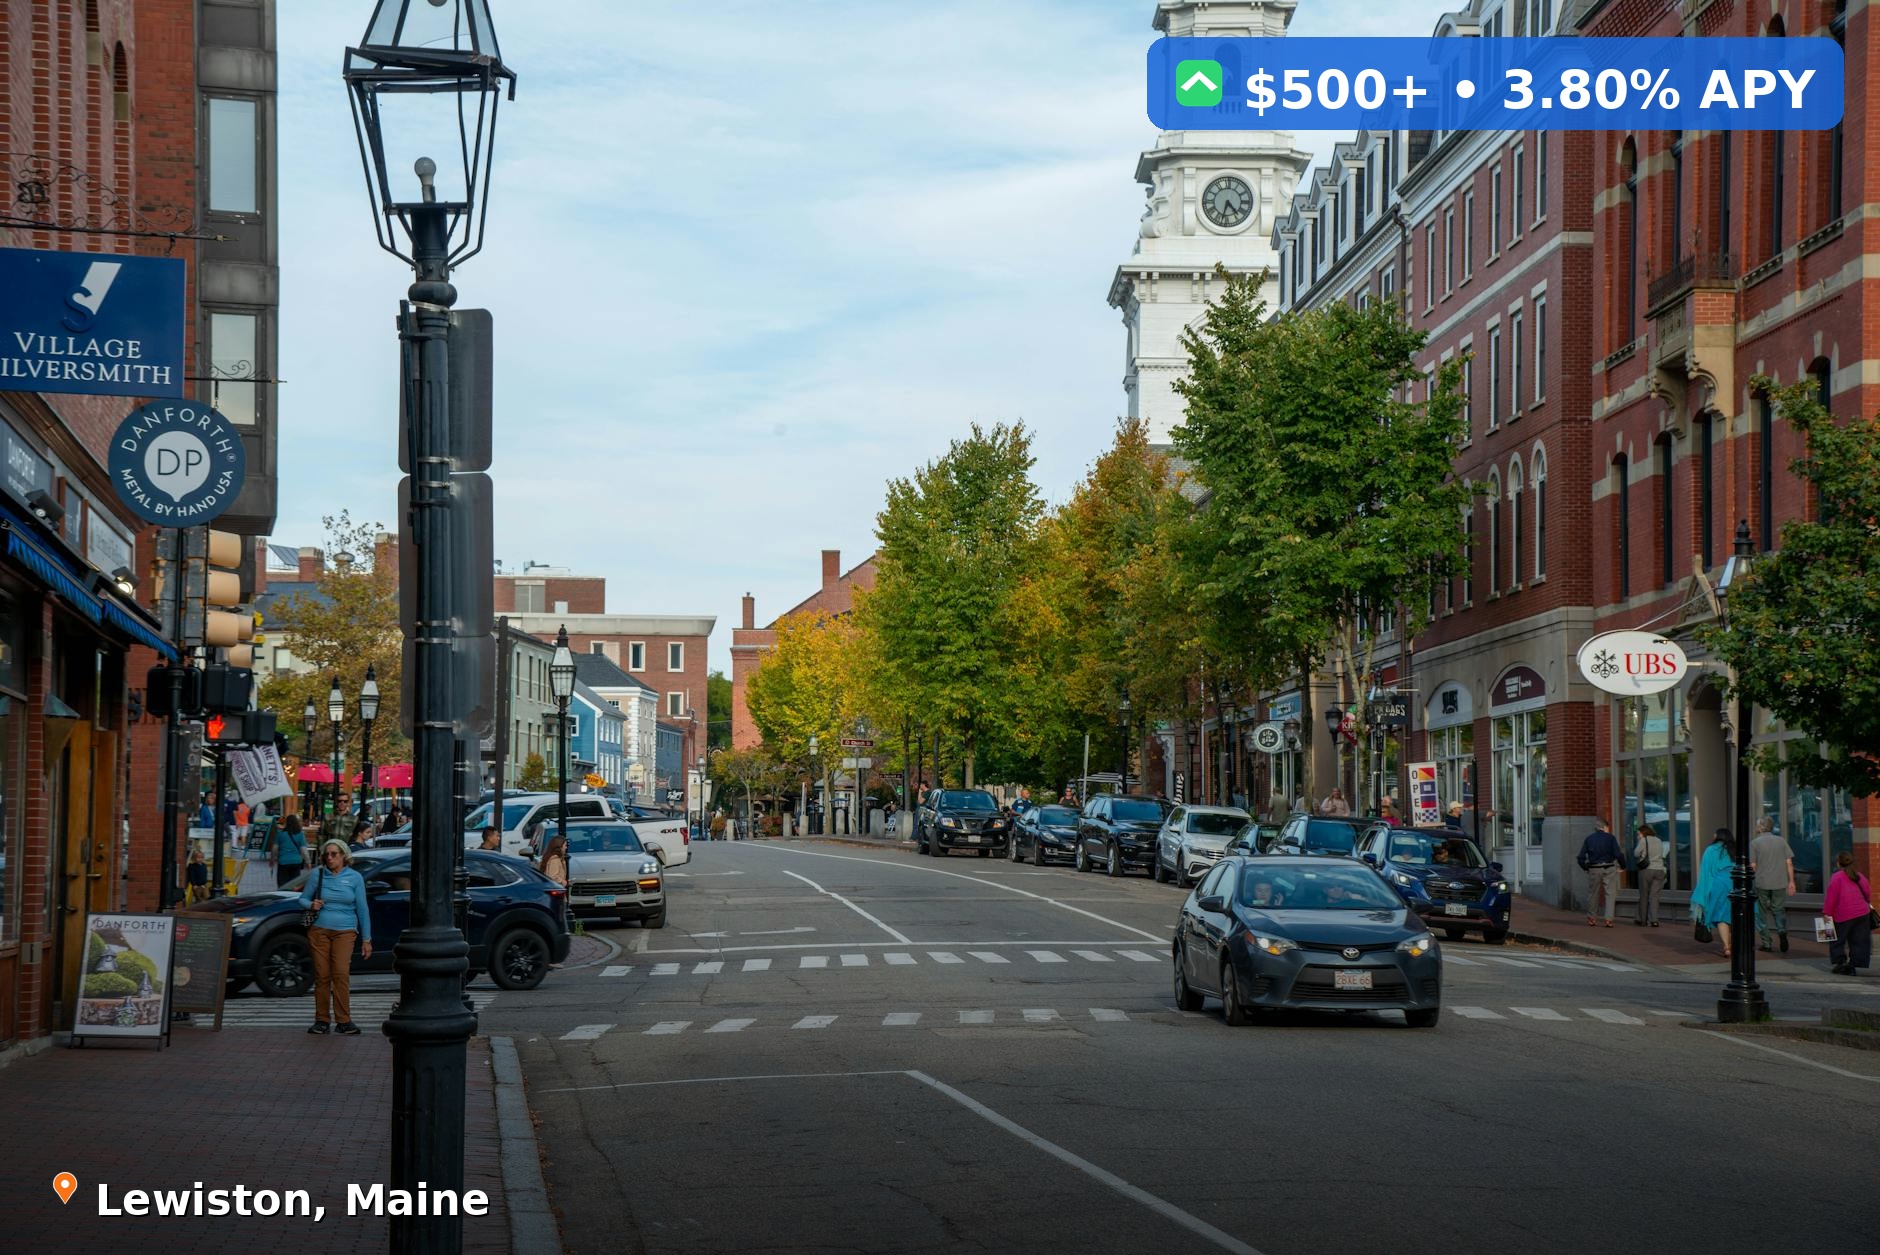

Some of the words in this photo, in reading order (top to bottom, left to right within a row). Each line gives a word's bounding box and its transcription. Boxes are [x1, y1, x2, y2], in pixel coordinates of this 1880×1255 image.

[14, 331, 142, 359] VILLAGE
[0, 357, 172, 385] ILVERSMITH
[157, 448, 202, 476] DP
[121, 468, 151, 504] METAL
[155, 498, 174, 517] BY
[177, 490, 217, 517] HAND
[214, 470, 234, 495] USA
[1624, 653, 1677, 675] UBS
[1411, 770, 1421, 821] OPEN
[96, 919, 166, 931] DANFORTH
